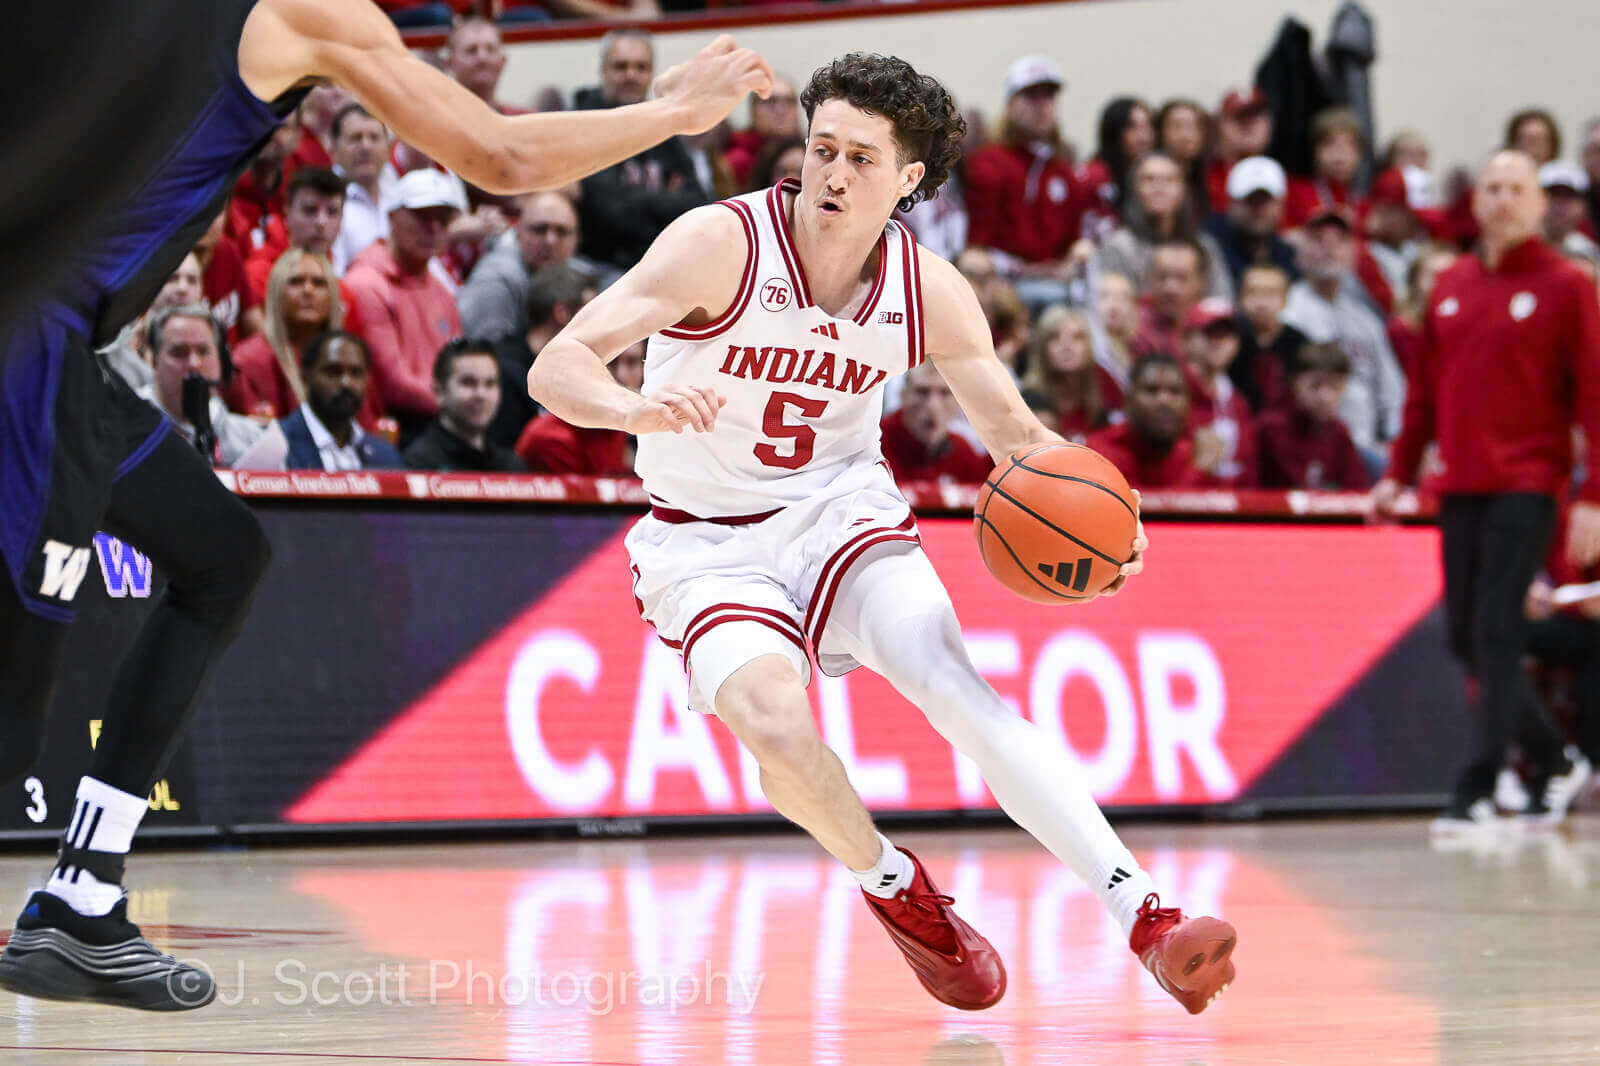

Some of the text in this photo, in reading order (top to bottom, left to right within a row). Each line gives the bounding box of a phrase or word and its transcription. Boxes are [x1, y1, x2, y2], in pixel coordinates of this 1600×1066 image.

[753, 391, 829, 470] 5
[40, 539, 91, 601] W
[93, 531, 152, 598] W
